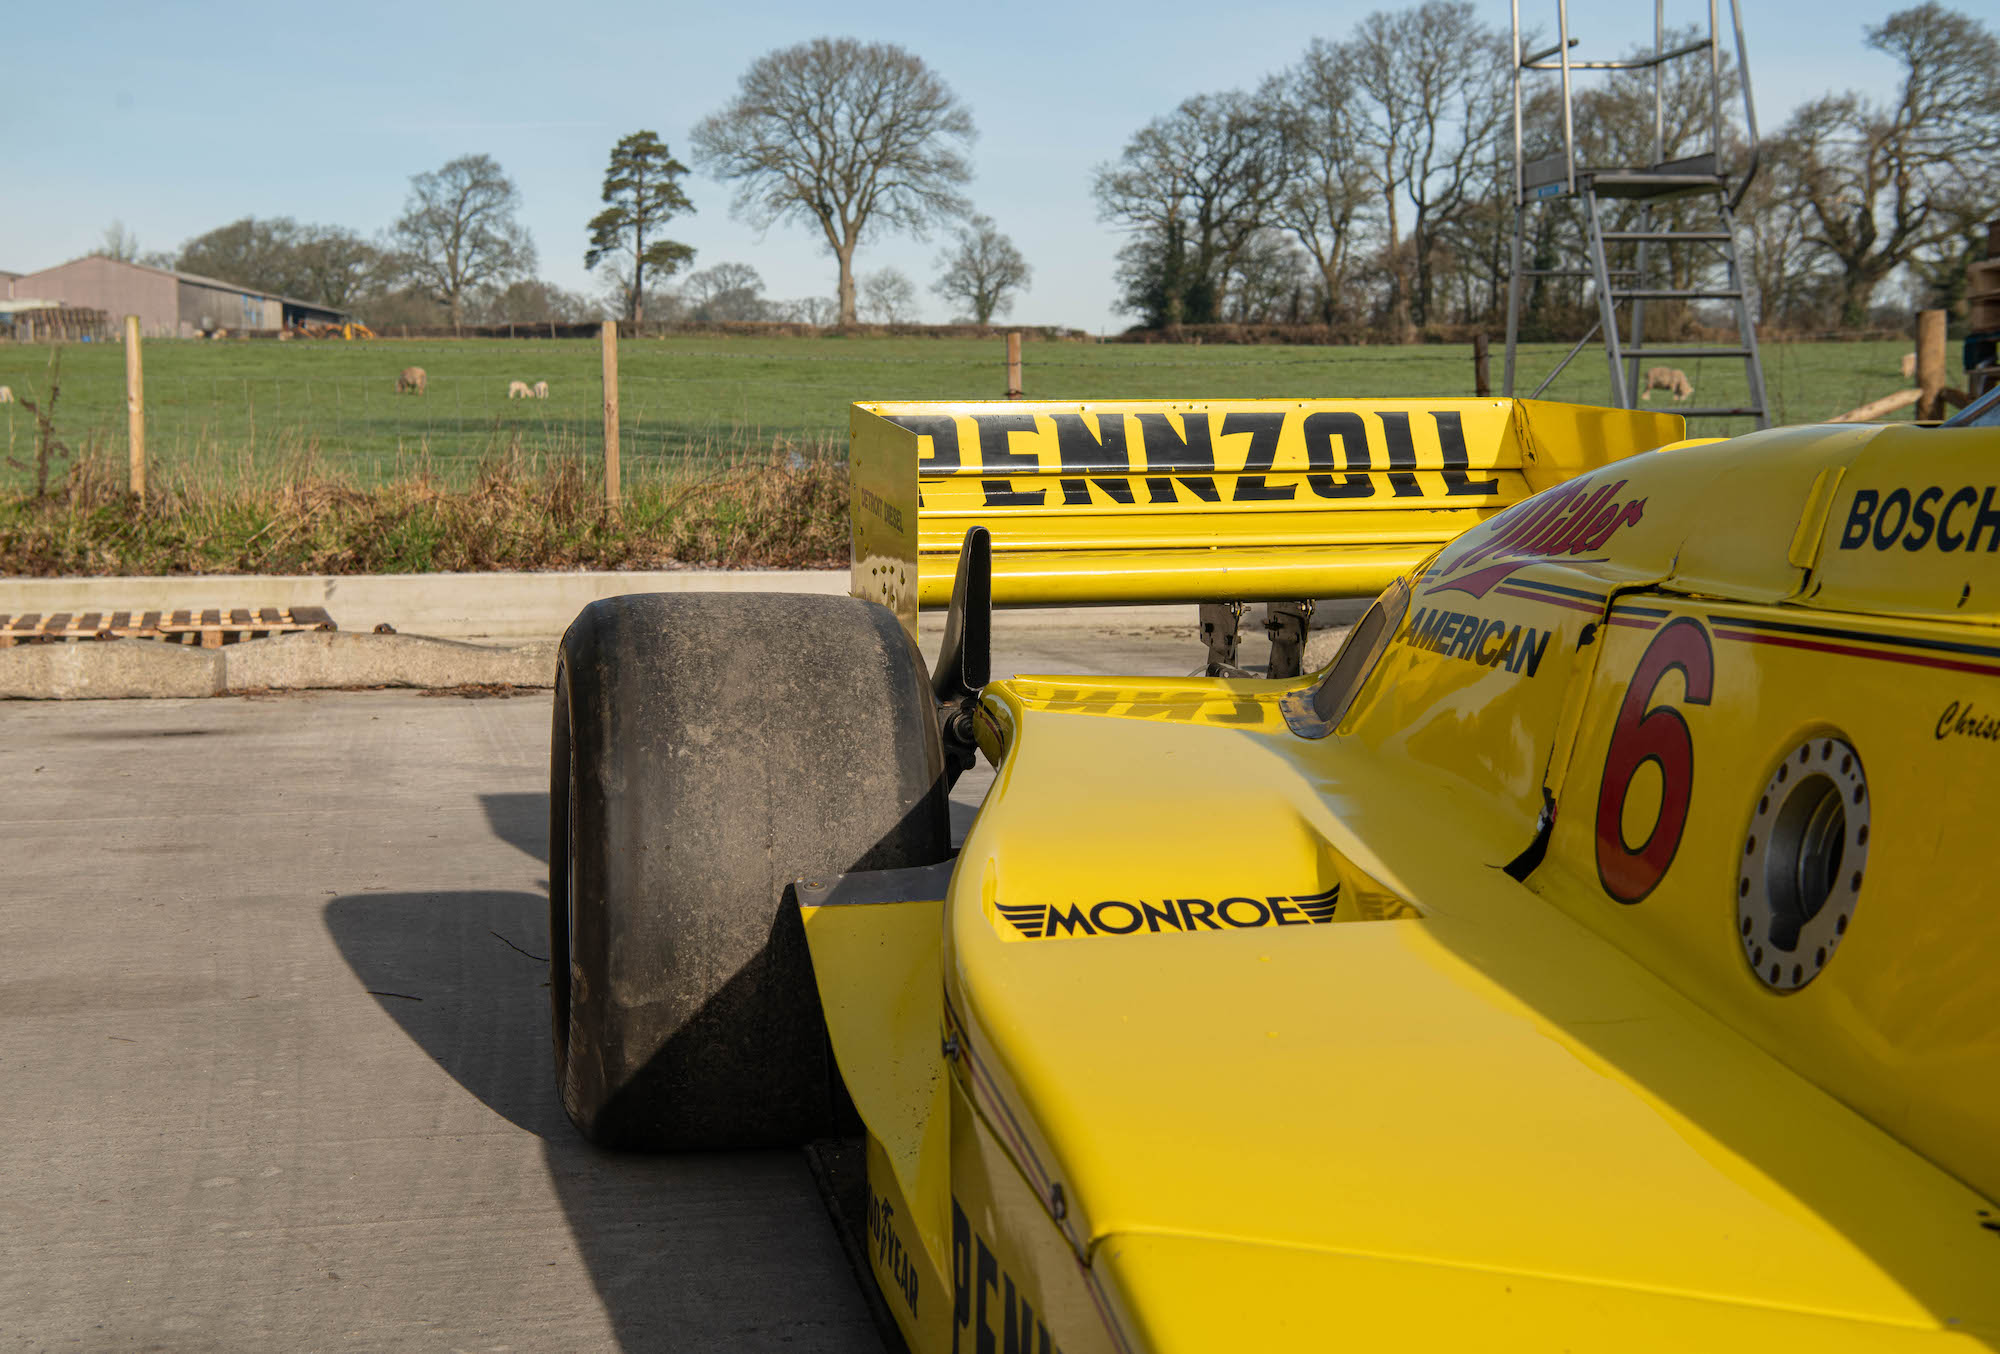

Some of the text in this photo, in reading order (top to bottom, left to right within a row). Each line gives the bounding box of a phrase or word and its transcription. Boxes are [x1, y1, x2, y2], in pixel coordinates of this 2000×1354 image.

[886, 411, 1500, 506] PENNZOIL
[1441, 475, 1649, 577] Miller
[1840, 486, 2000, 553] BOSCH
[1397, 607, 1552, 678] AMERICAN
[1595, 616, 1714, 905] 6
[1045, 897, 1315, 938] MONROE
